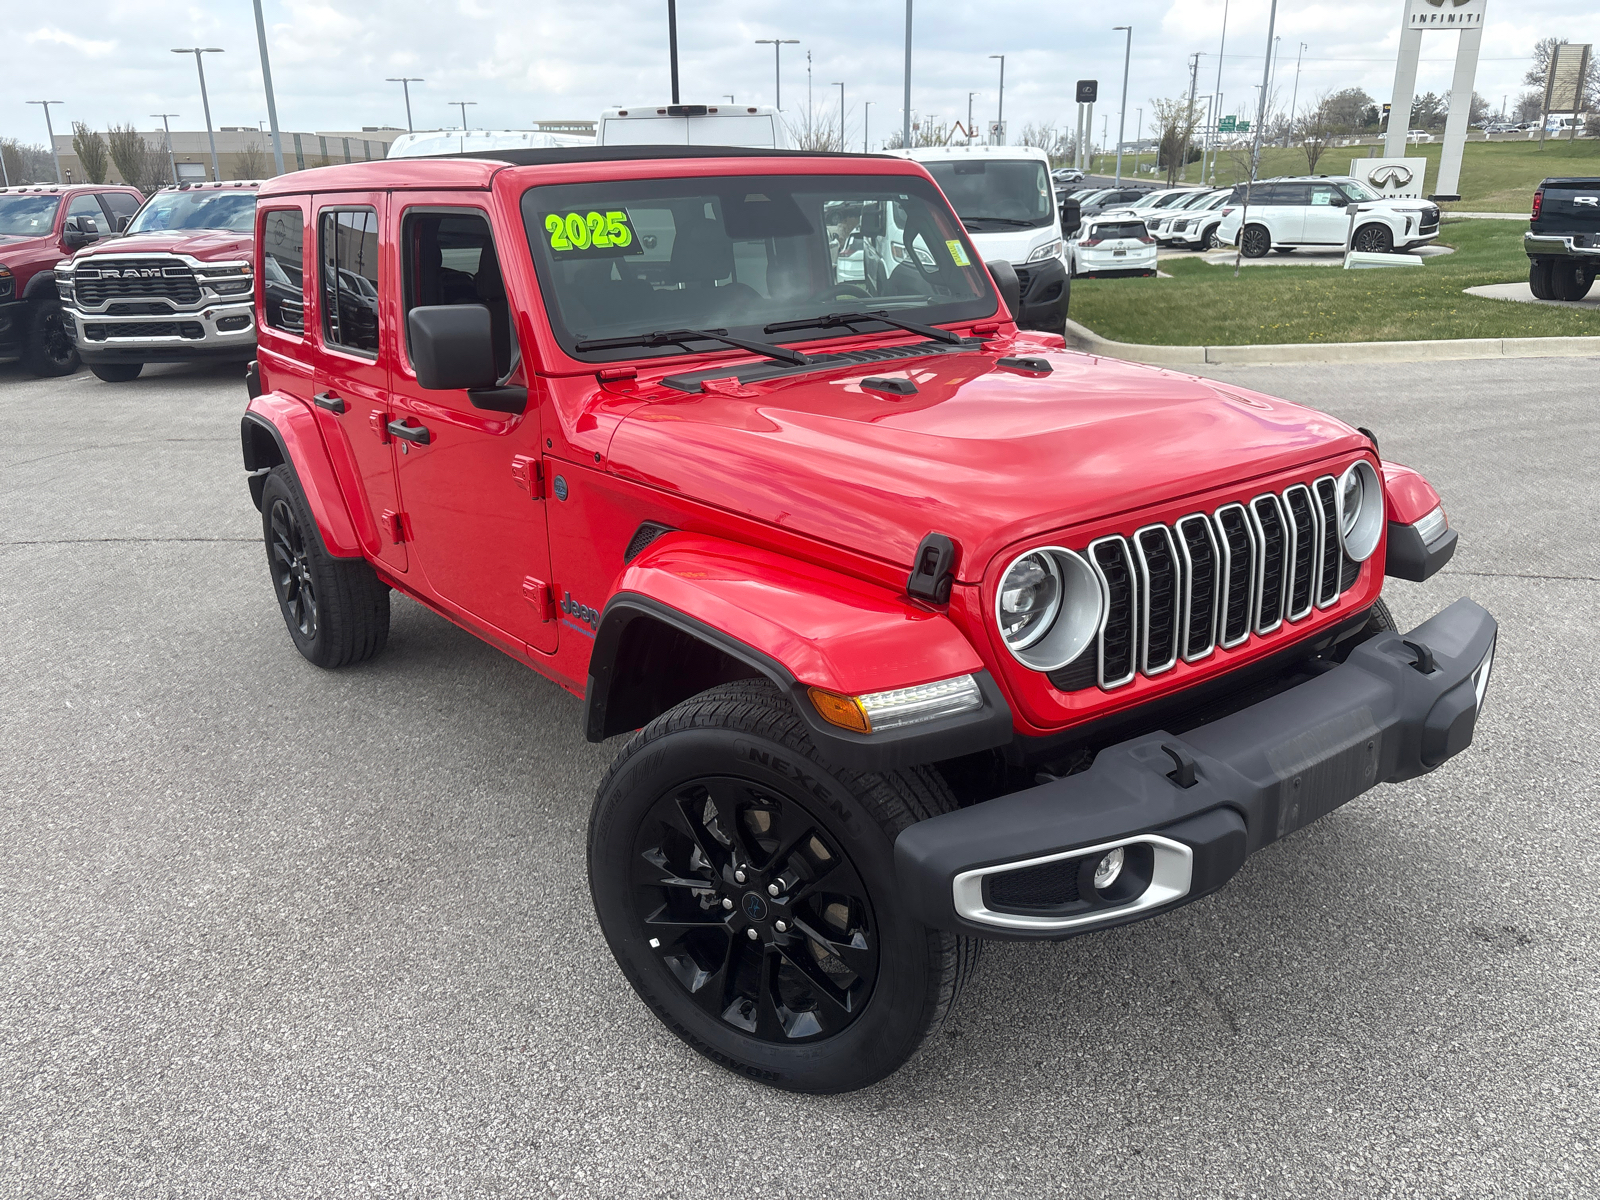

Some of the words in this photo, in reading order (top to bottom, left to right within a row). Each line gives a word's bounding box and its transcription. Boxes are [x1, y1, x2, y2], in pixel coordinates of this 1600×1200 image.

[1412, 13, 1480, 23] INFINITI
[545, 211, 632, 251] 2025
[101, 268, 161, 279] RAM
[560, 590, 600, 631] Jeep
[749, 746, 853, 822] NEXEN
[672, 1020, 781, 1082] ROADIAN
